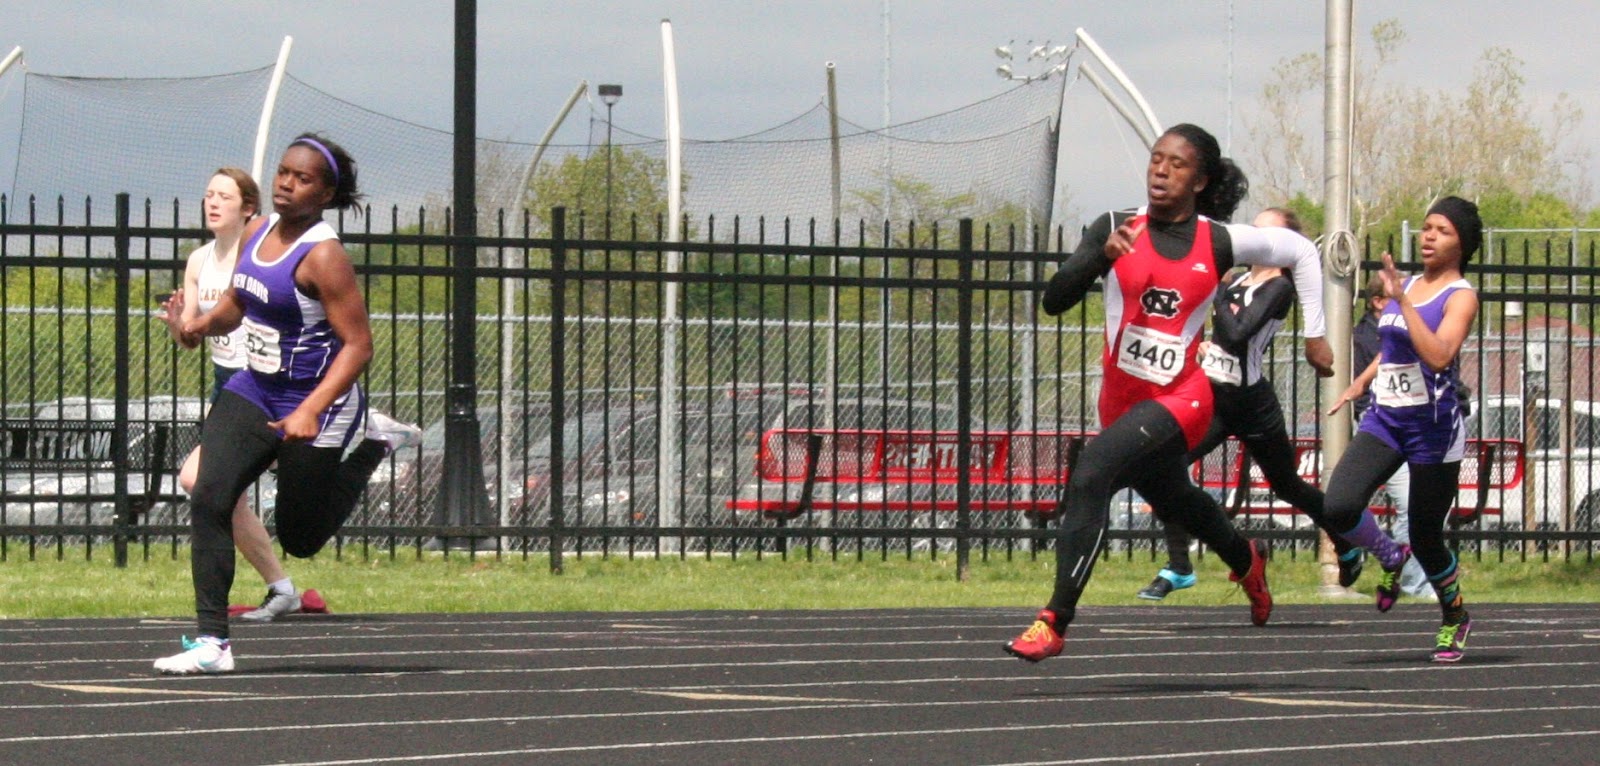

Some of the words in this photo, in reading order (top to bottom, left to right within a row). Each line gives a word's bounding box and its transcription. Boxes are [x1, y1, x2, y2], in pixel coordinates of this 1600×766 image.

[246, 276, 269, 304] DAVIS
[247, 333, 267, 356] 52
[1126, 339, 1176, 371] 440
[1387, 372, 1411, 393] 46
